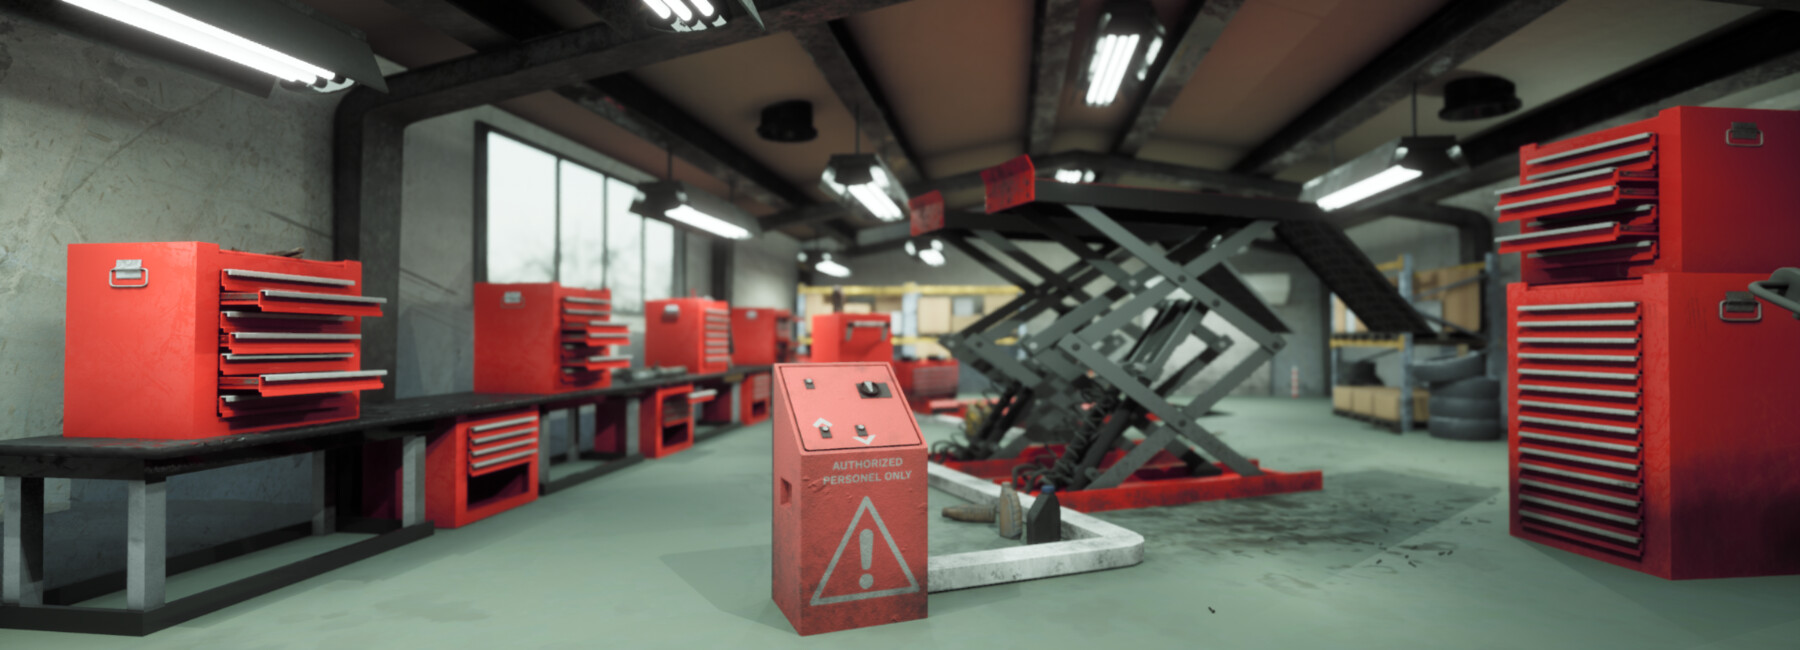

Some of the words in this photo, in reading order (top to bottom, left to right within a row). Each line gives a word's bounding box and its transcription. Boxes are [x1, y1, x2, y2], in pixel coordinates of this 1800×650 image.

[832, 457, 904, 471] AUTHORIZED
[823, 472, 882, 485] PERSONEL
[884, 470, 912, 481] ONLY
